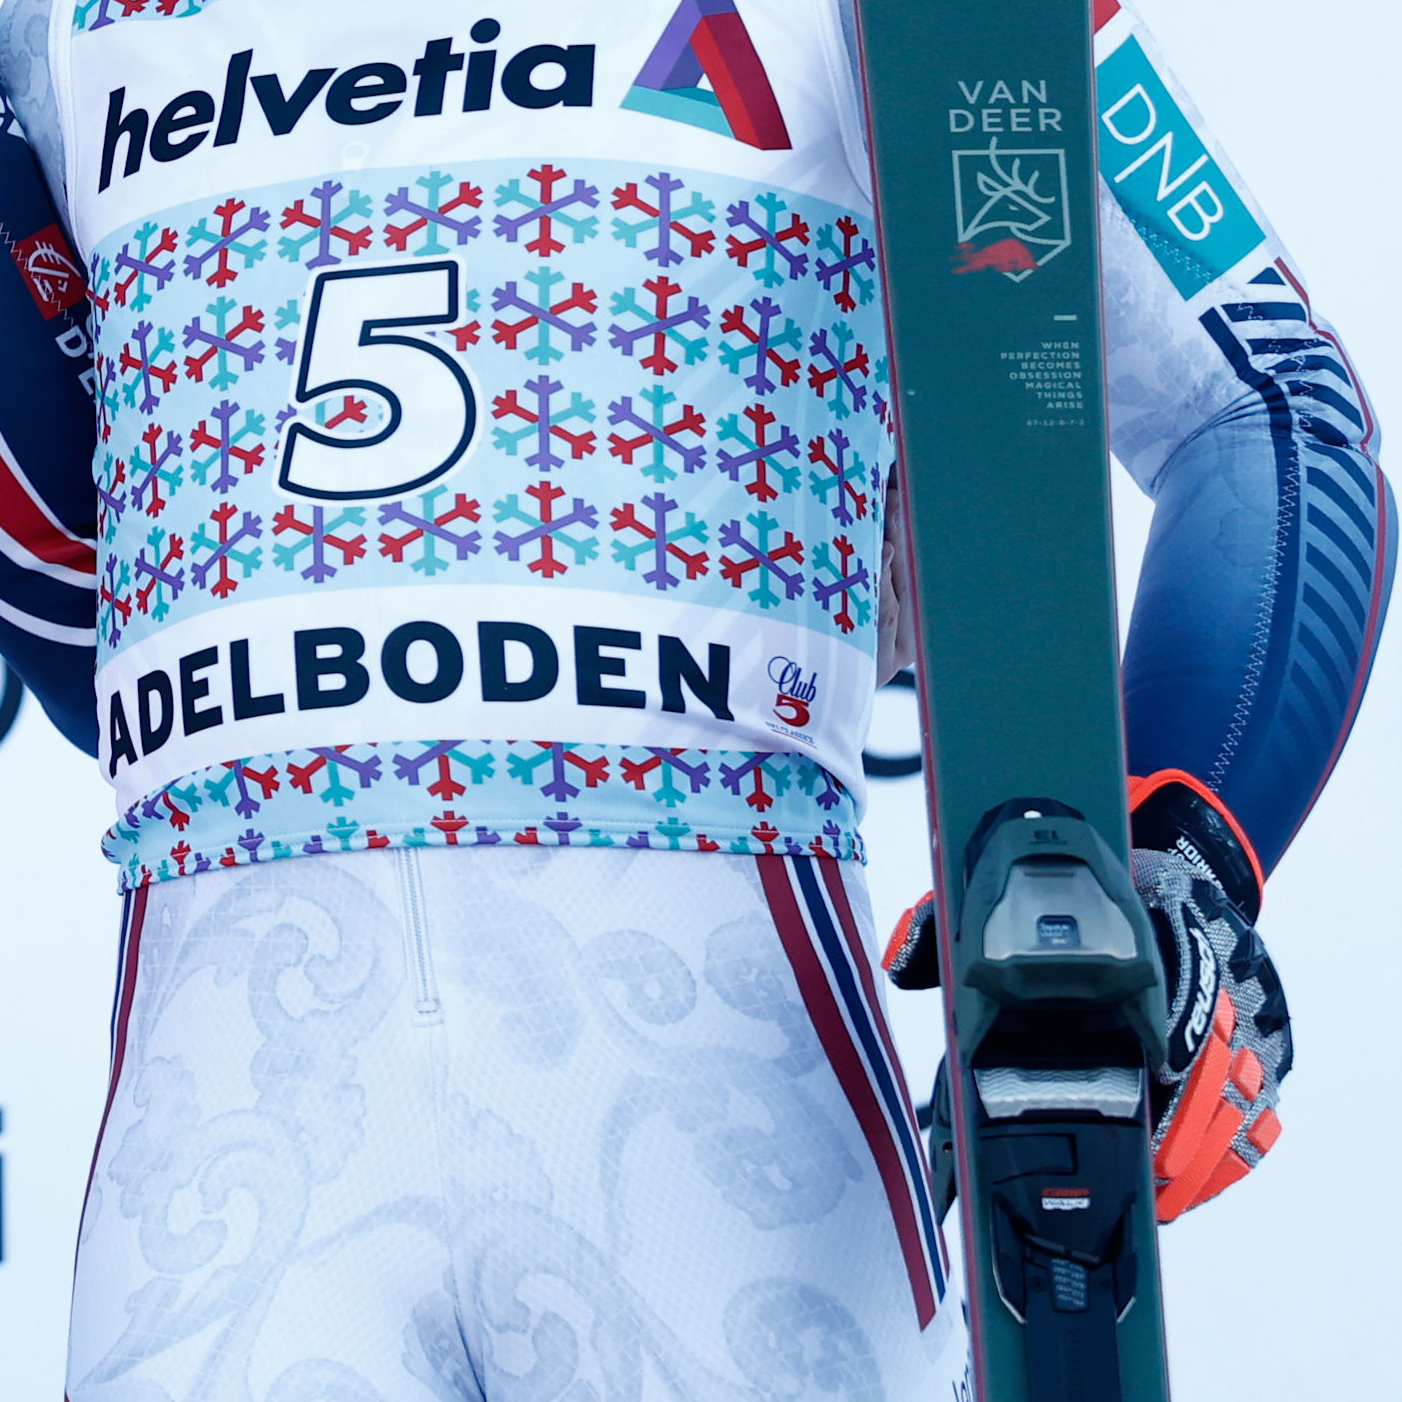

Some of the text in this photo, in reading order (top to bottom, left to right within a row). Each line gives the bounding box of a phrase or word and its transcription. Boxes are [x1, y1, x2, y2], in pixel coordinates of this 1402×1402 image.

[98, 17, 596, 193] helvetia
[958, 80, 1048, 104] VAN
[948, 108, 1063, 133] DEER
[1101, 83, 1224, 241] DNB
[1000, 352, 1081, 360] PERFECTION
[276, 259, 476, 502] 5
[108, 618, 734, 779] ADELBODEN
[767, 656, 818, 702] Club
[772, 693, 810, 727] 5
